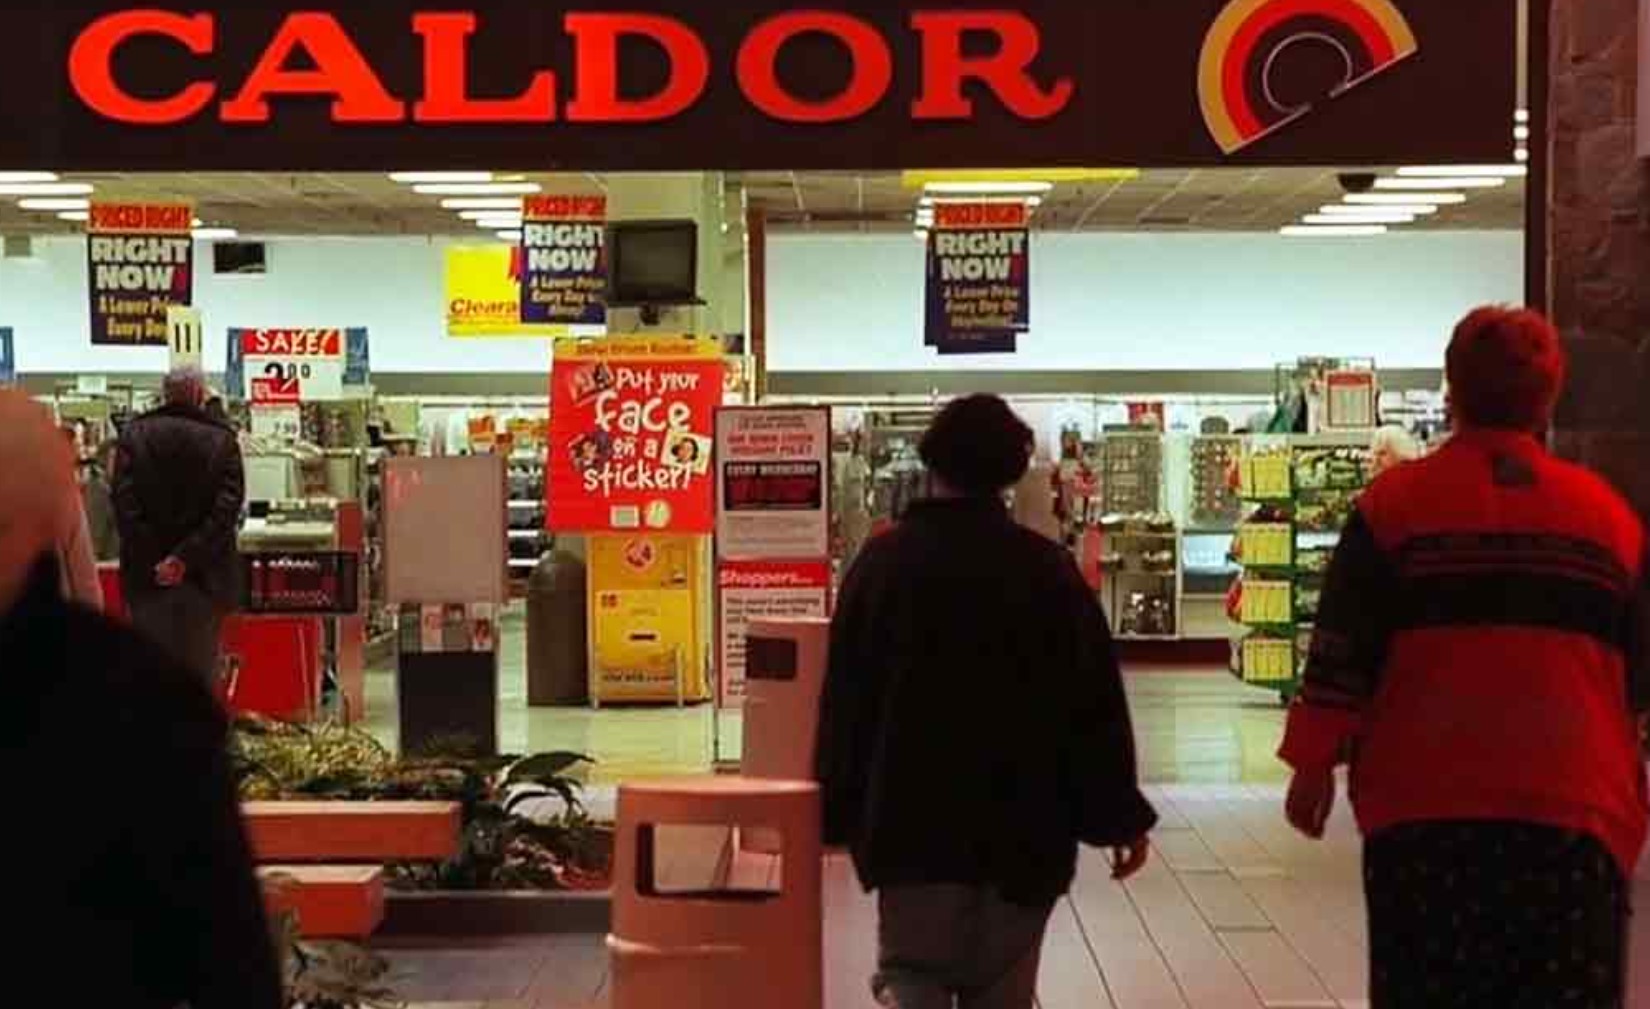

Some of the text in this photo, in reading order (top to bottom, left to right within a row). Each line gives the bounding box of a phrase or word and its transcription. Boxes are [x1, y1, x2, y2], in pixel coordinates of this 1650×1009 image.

[69, 10, 1071, 123] CALDOR
[524, 223, 604, 247] RIGHT
[936, 232, 1025, 254] RIGHT
[91, 237, 190, 262] RIGHT
[616, 367, 654, 395] Put
[643, 438, 659, 459] a
[583, 459, 691, 498] sticker!
